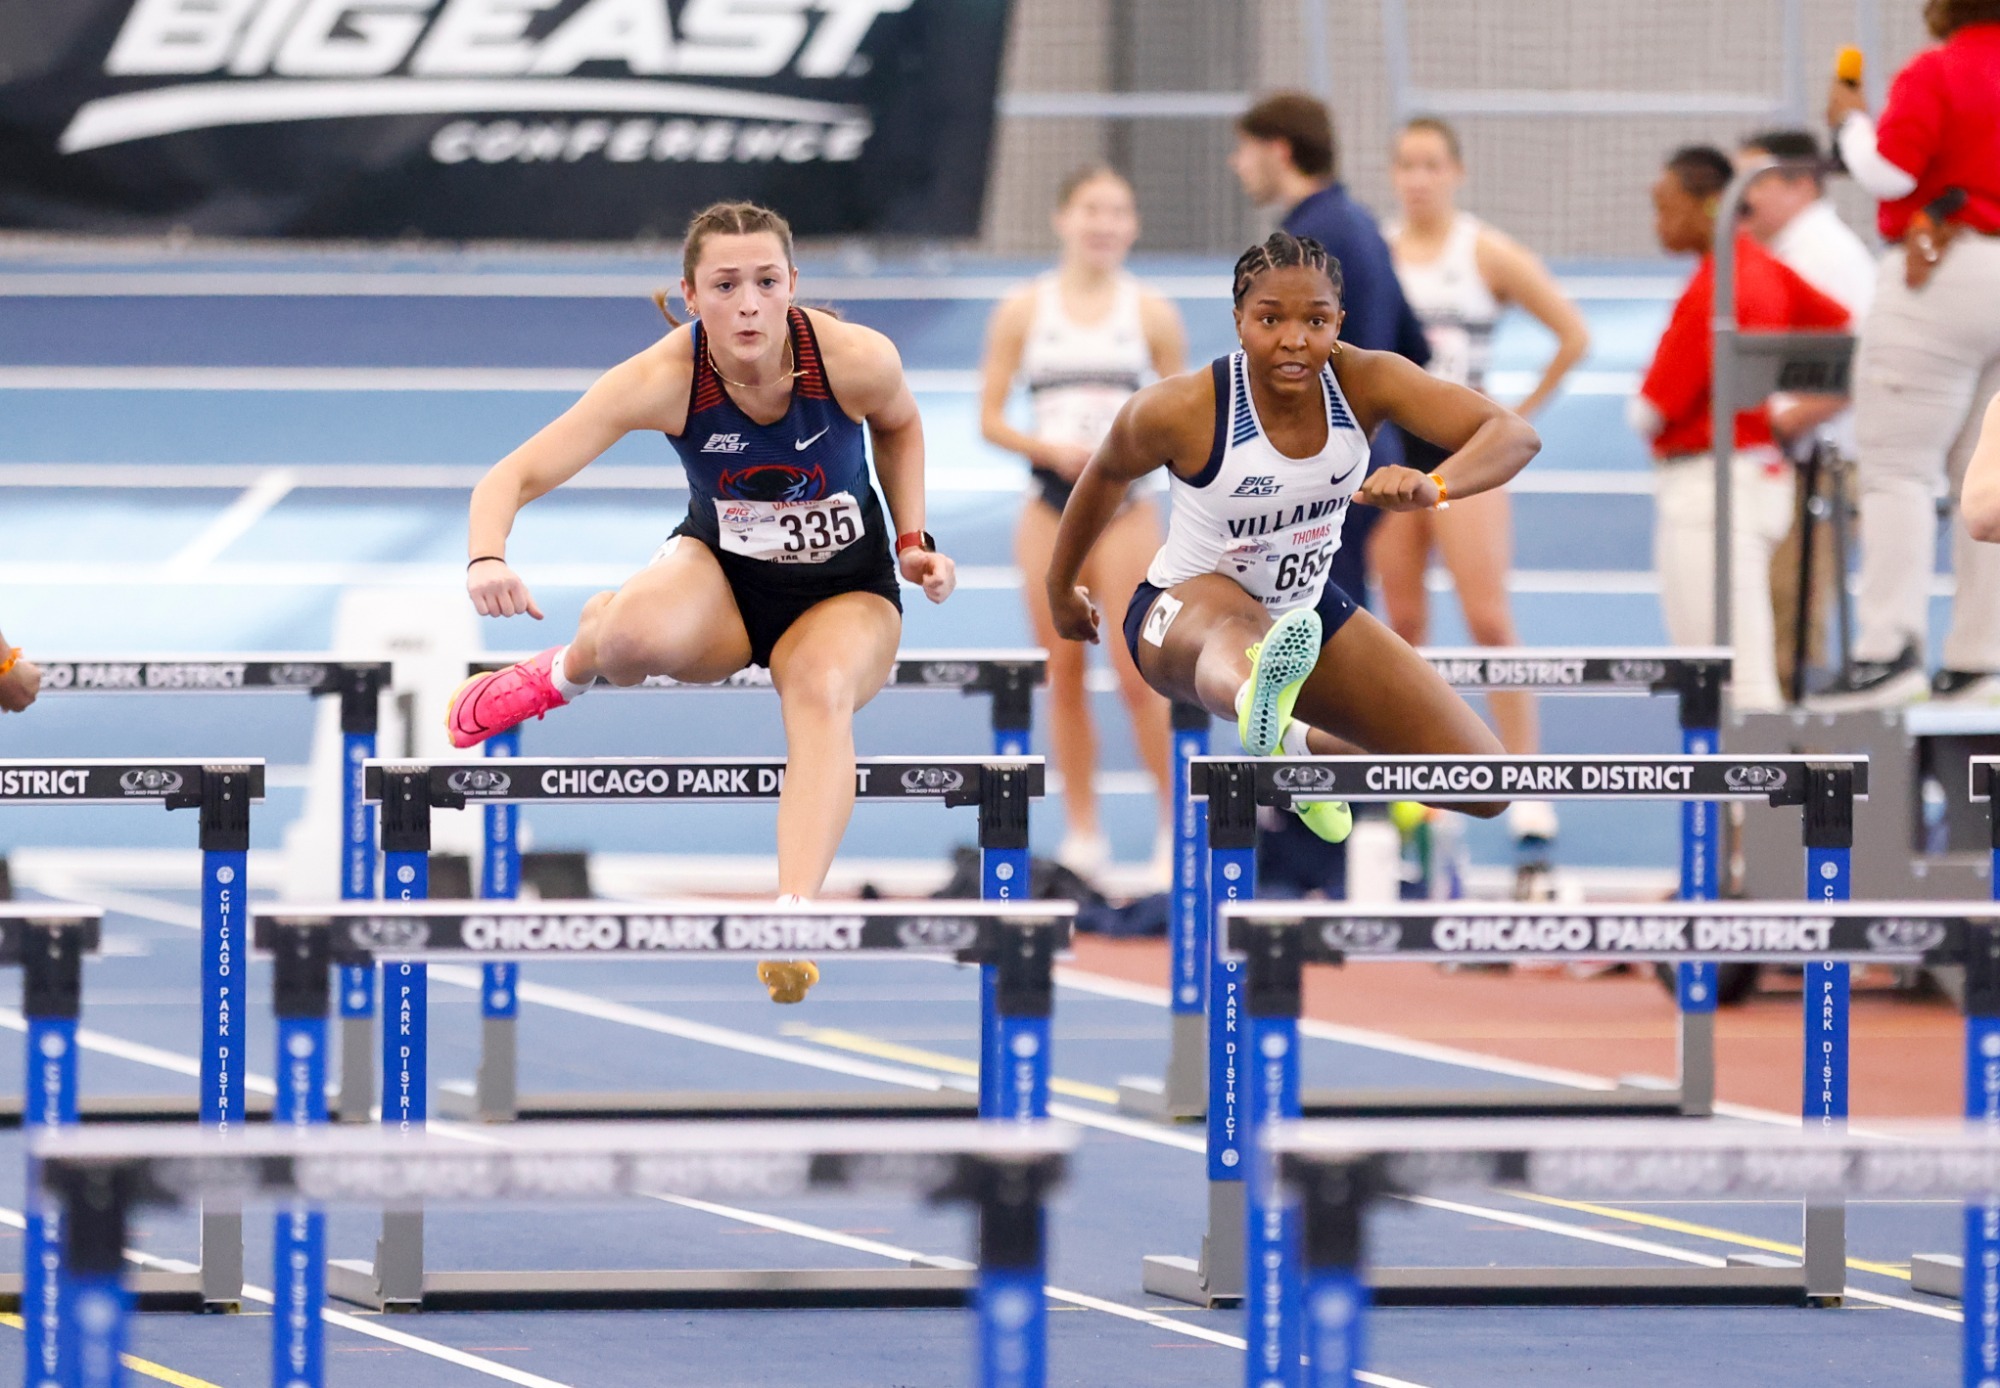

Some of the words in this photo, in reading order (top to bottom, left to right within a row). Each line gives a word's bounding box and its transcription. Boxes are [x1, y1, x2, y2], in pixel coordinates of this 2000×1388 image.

[431, 121, 870, 164] CONFERENCE
[703, 441, 750, 451] EAST
[709, 433, 742, 442] BIG
[1233, 485, 1284, 495] EAST
[1241, 476, 1276, 486] BIG
[726, 507, 751, 516] BIG
[780, 506, 857, 552] 335
[1228, 494, 1352, 539] VILLANOV
[1292, 523, 1332, 546] THOMAS
[76, 664, 144, 688] PARK
[145, 664, 246, 688] DISTRICT
[1437, 660, 1483, 684] ARK
[1486, 660, 1587, 685] DISTRICT
[0, 769, 90, 795] STRICT
[541, 769, 669, 794] CHICAGO
[677, 769, 750, 793] PARK
[1365, 766, 1494, 791] CHICAGO
[1501, 766, 1573, 790] PARK
[1582, 766, 1694, 790] DISTRICT
[218, 889, 231, 976] CHICAGO
[461, 916, 623, 950] CHICAGO
[625, 916, 719, 950] PARK
[723, 916, 867, 950] DISTRICT
[1431, 916, 1594, 951] CHICAGO
[1599, 916, 1689, 951] PARK
[1693, 916, 1837, 950] DISTRICT
[218, 987, 230, 1037] PARK
[400, 986, 411, 1036] PARK
[1227, 983, 1237, 1032] PARK
[1822, 982, 1834, 1031] PARK
[218, 1047, 229, 1134] DISTRIC
[400, 1047, 411, 1133] DISTRIC
[1226, 1043, 1236, 1141] DISTRICT
[1822, 1042, 1833, 1128] DISTRIC
